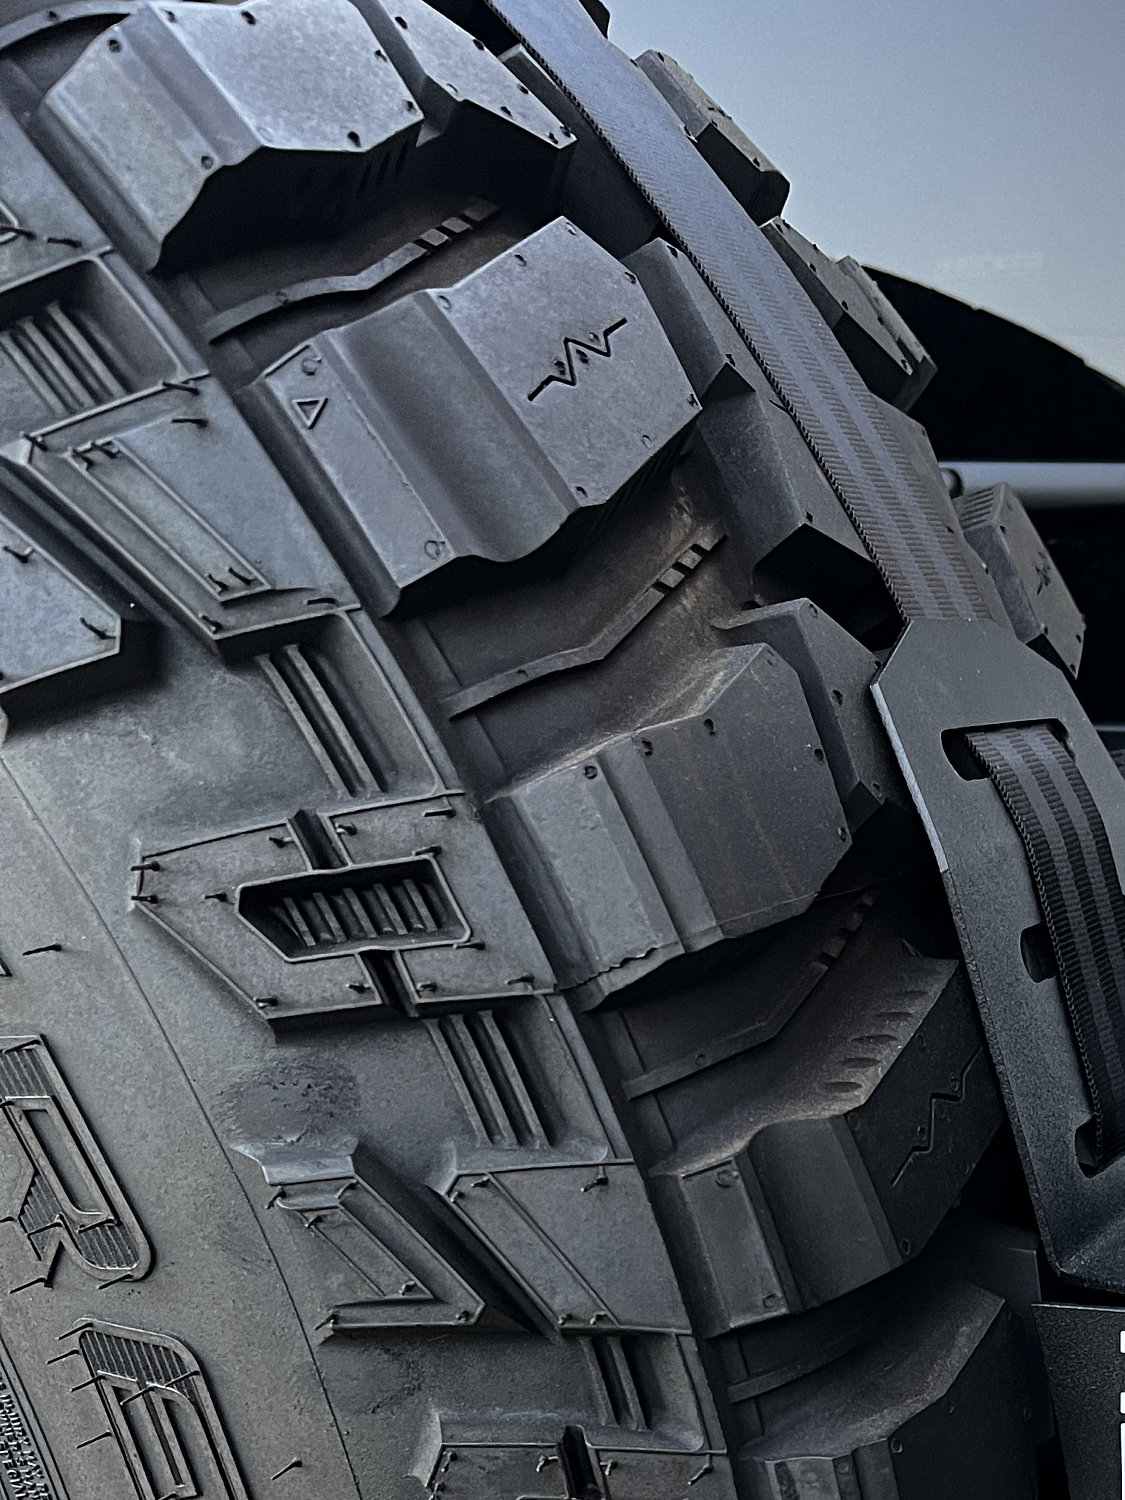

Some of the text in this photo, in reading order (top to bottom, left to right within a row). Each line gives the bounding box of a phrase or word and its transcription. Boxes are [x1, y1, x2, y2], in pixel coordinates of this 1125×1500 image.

[0, 1403, 27, 1467] WNER'S
[0, 1390, 30, 1448] INJURY
[22, 1446, 44, 1482] MAY
